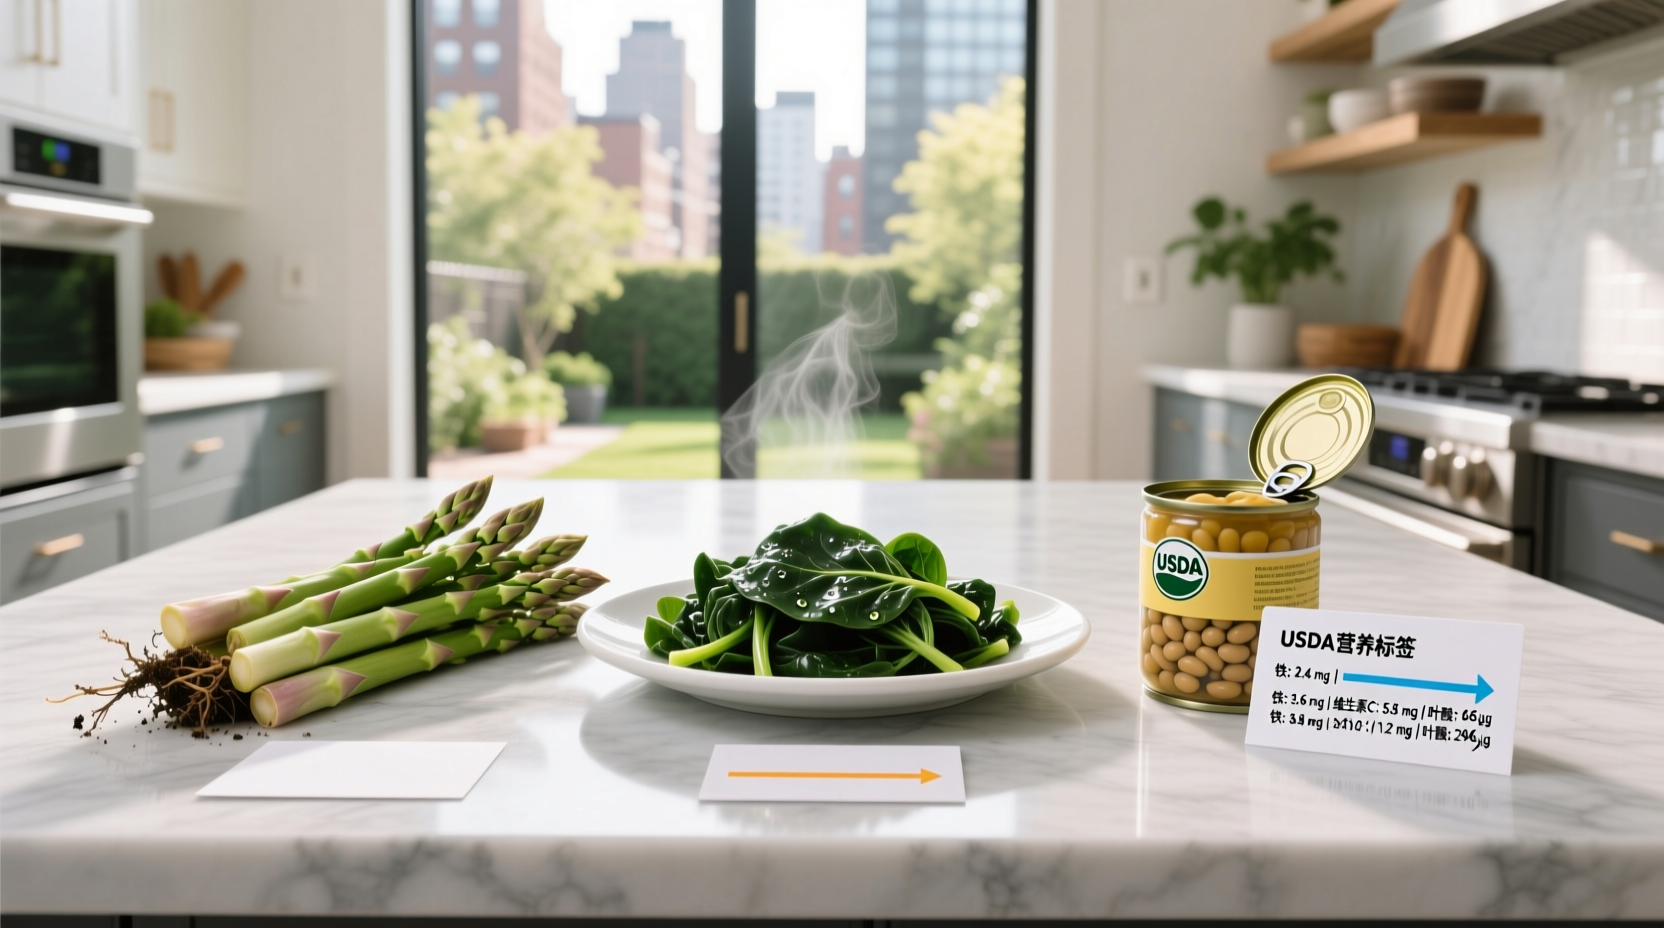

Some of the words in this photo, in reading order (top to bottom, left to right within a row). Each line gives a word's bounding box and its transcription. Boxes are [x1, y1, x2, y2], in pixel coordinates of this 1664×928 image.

[1157, 552, 1203, 576] USDA
[1280, 630, 1417, 659] USDA营养标签
[1294, 665, 1311, 679] 2.4
[1314, 670, 1330, 684] mg
[1401, 707, 1418, 721] mg
[1396, 725, 1413, 740] mg
